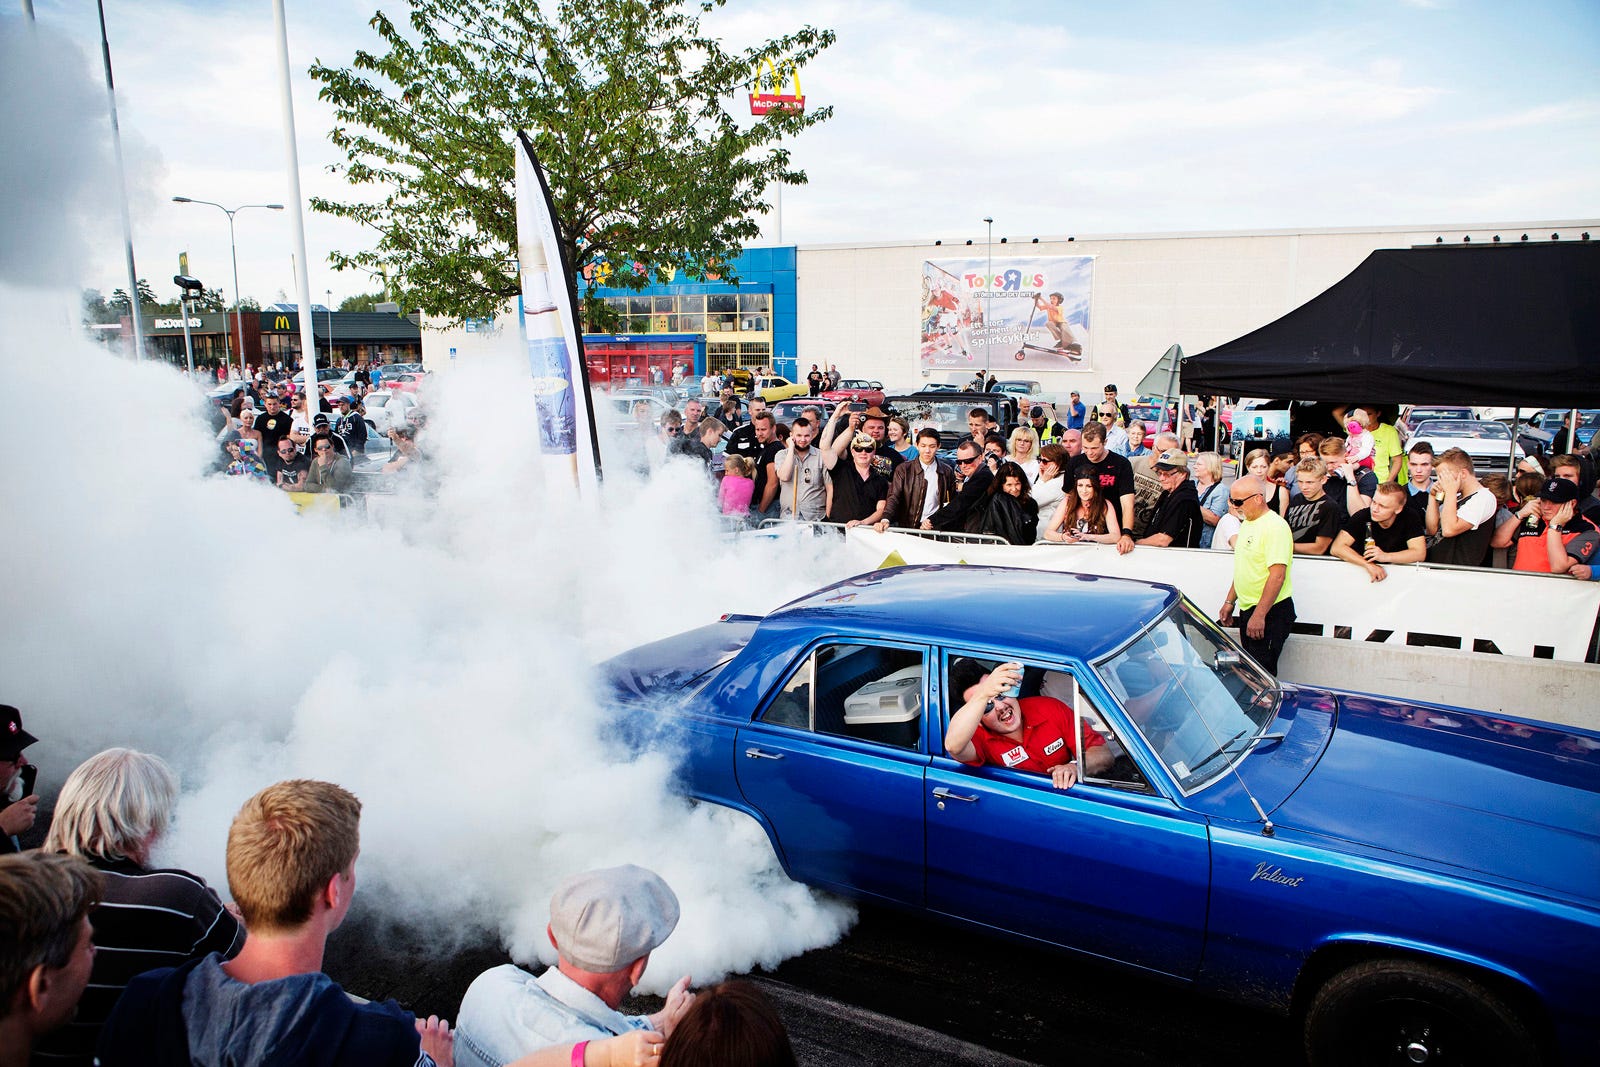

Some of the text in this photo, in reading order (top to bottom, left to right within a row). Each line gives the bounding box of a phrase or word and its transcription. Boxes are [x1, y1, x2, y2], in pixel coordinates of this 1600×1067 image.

[752, 100, 803, 108] McDoa's
[154, 318, 202, 329] McDond's
[971, 326, 1009, 336] sortment
[1581, 541, 1593, 556] 3
[1250, 861, 1304, 887] Valiant
